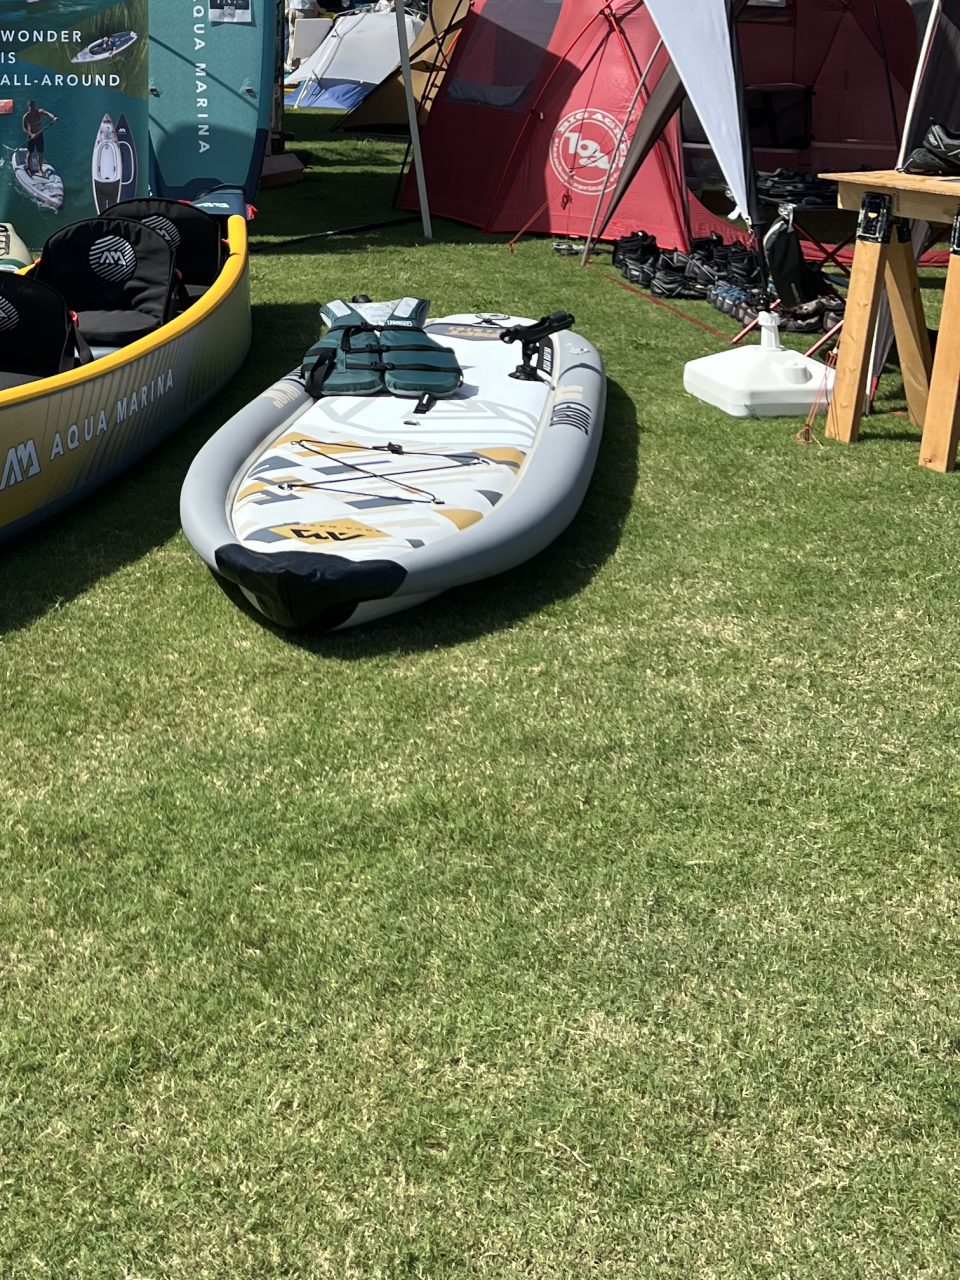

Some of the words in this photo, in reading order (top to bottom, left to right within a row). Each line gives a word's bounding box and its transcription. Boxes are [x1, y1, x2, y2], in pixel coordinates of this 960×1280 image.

[0, 30, 82, 43] WONDER
[1, 52, 16, 64] IS
[0, 74, 120, 87] ALL-AROUND
[195, 62, 211, 154] MARINA
[50, 409, 108, 461] AQUA
[116, 368, 175, 424] MARINA
